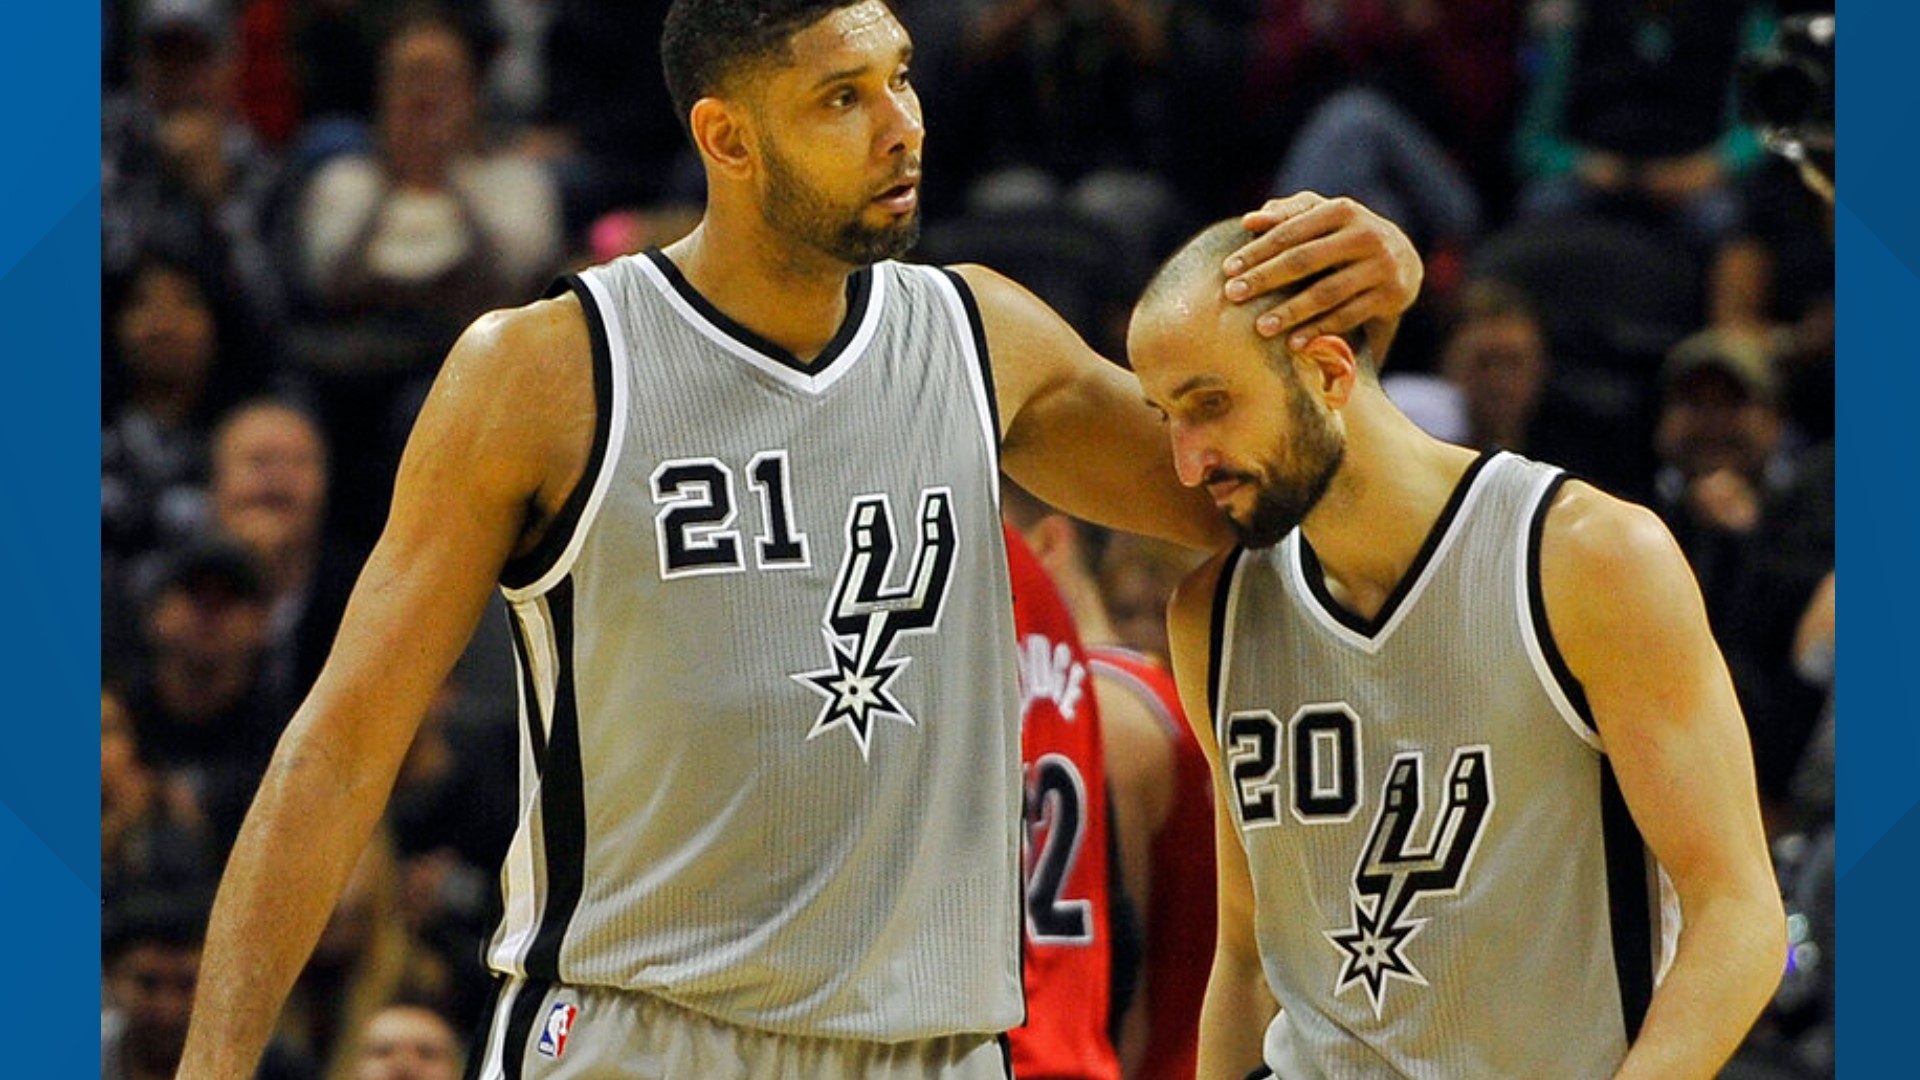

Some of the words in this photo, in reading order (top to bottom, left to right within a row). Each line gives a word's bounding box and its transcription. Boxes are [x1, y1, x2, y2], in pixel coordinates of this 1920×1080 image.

[650, 449, 811, 580] 21
[1017, 632, 1085, 720] DGE
[1227, 701, 1364, 831] 20
[1022, 752, 1094, 945] 2
